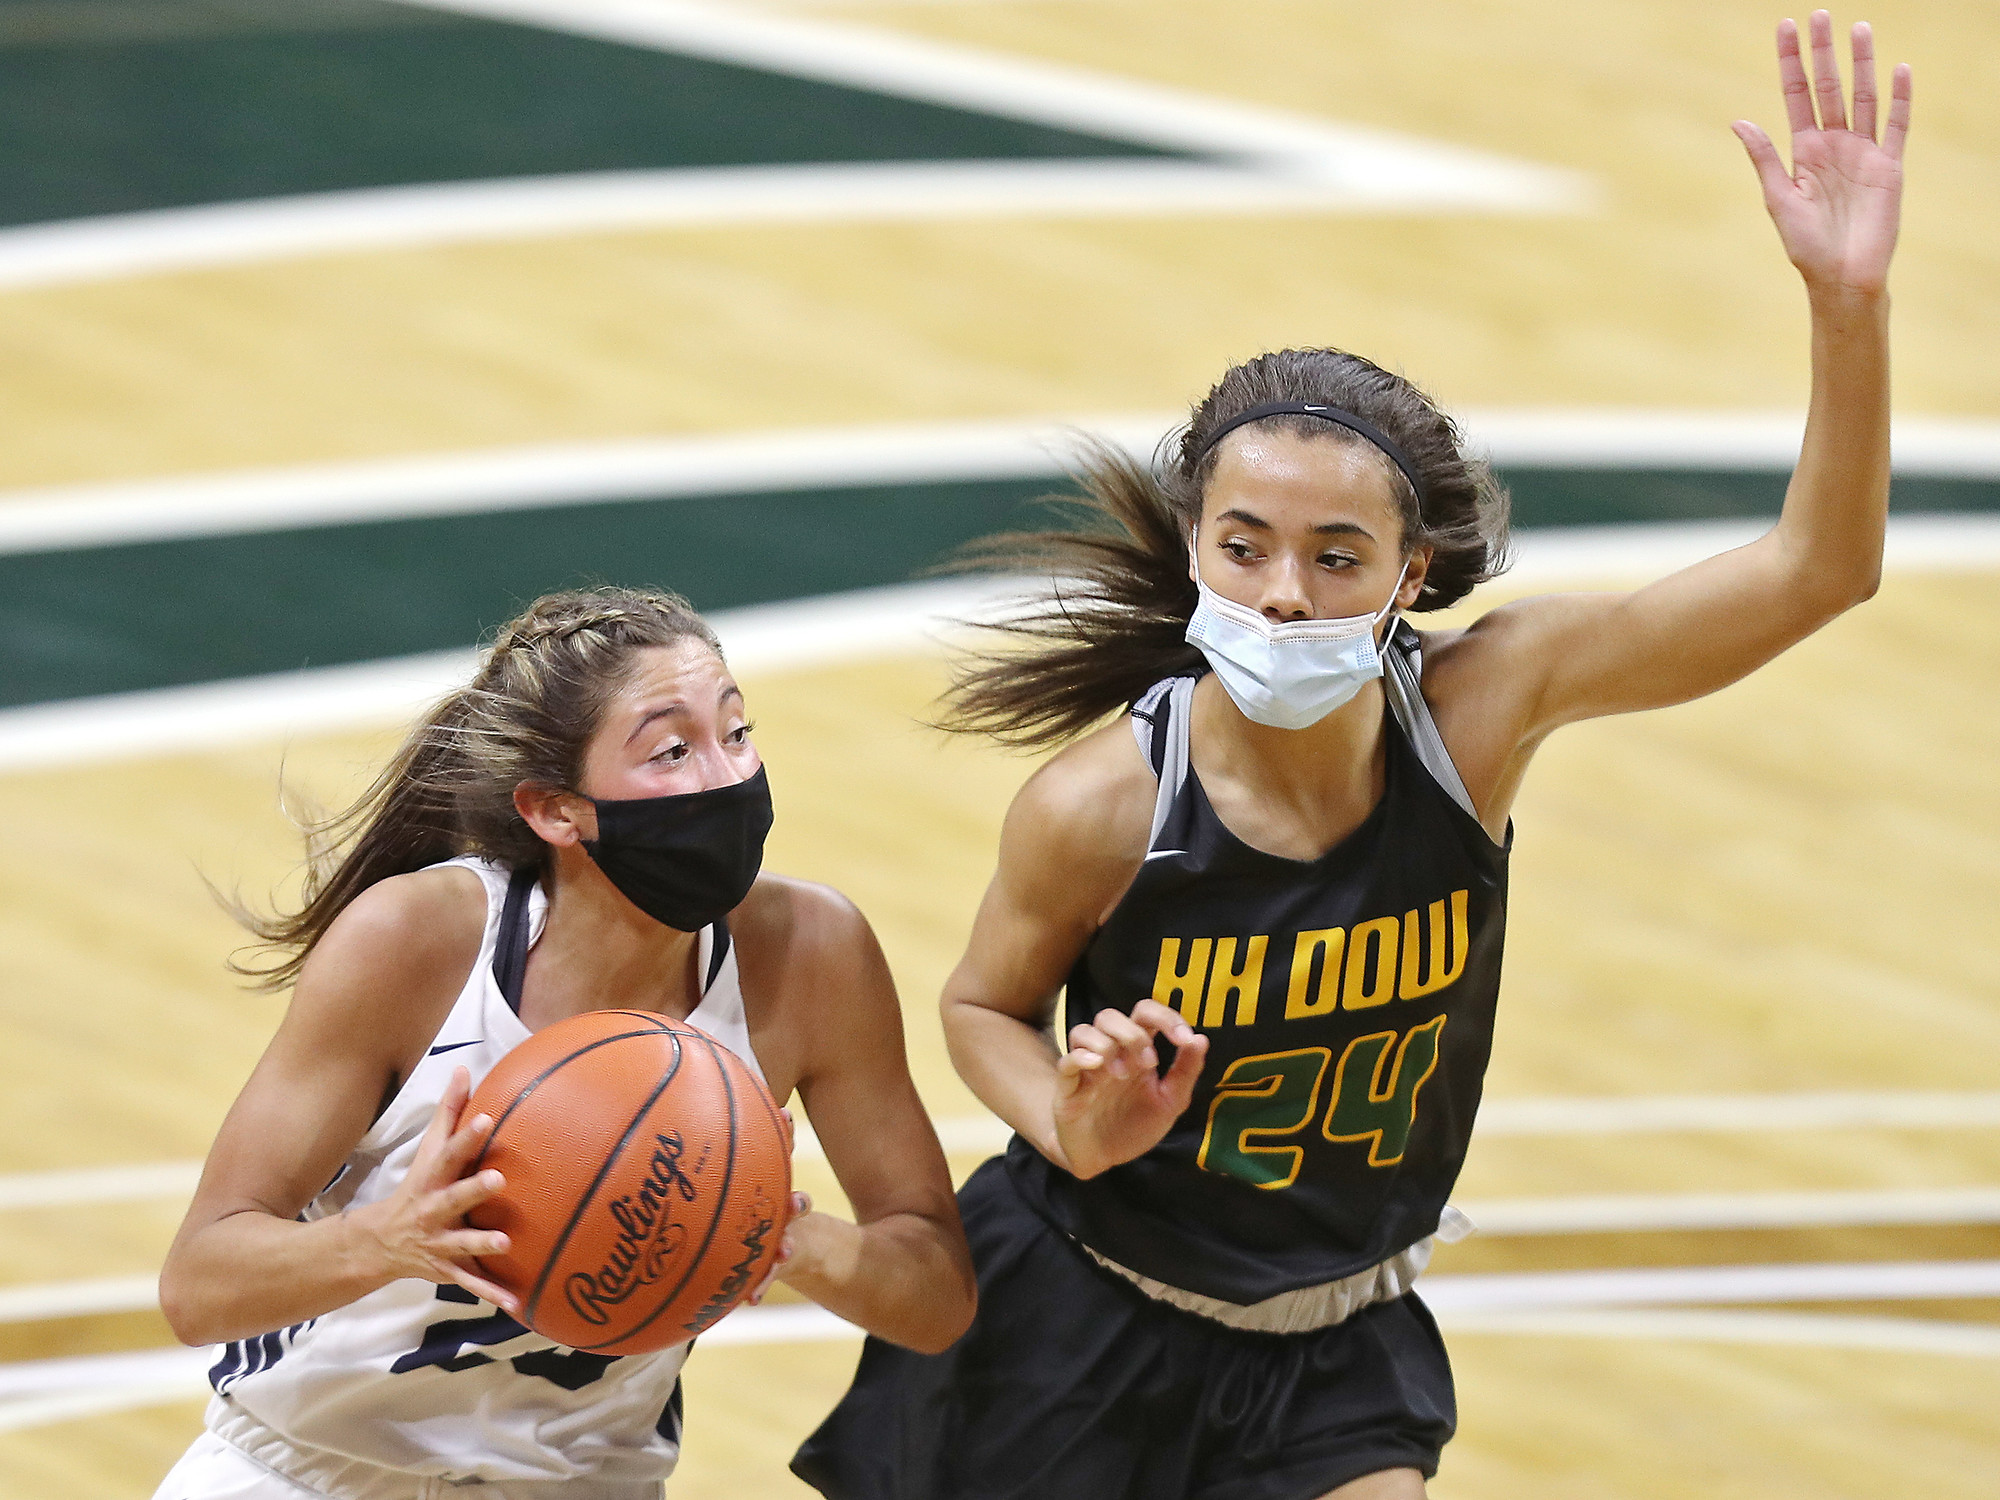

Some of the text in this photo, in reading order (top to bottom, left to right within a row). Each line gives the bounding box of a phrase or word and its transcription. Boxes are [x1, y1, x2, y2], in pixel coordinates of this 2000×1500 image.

[1151, 888, 1470, 1028] HH DOW
[1196, 1013, 1447, 1191] 24
[564, 1128, 697, 1326] Rawlings
